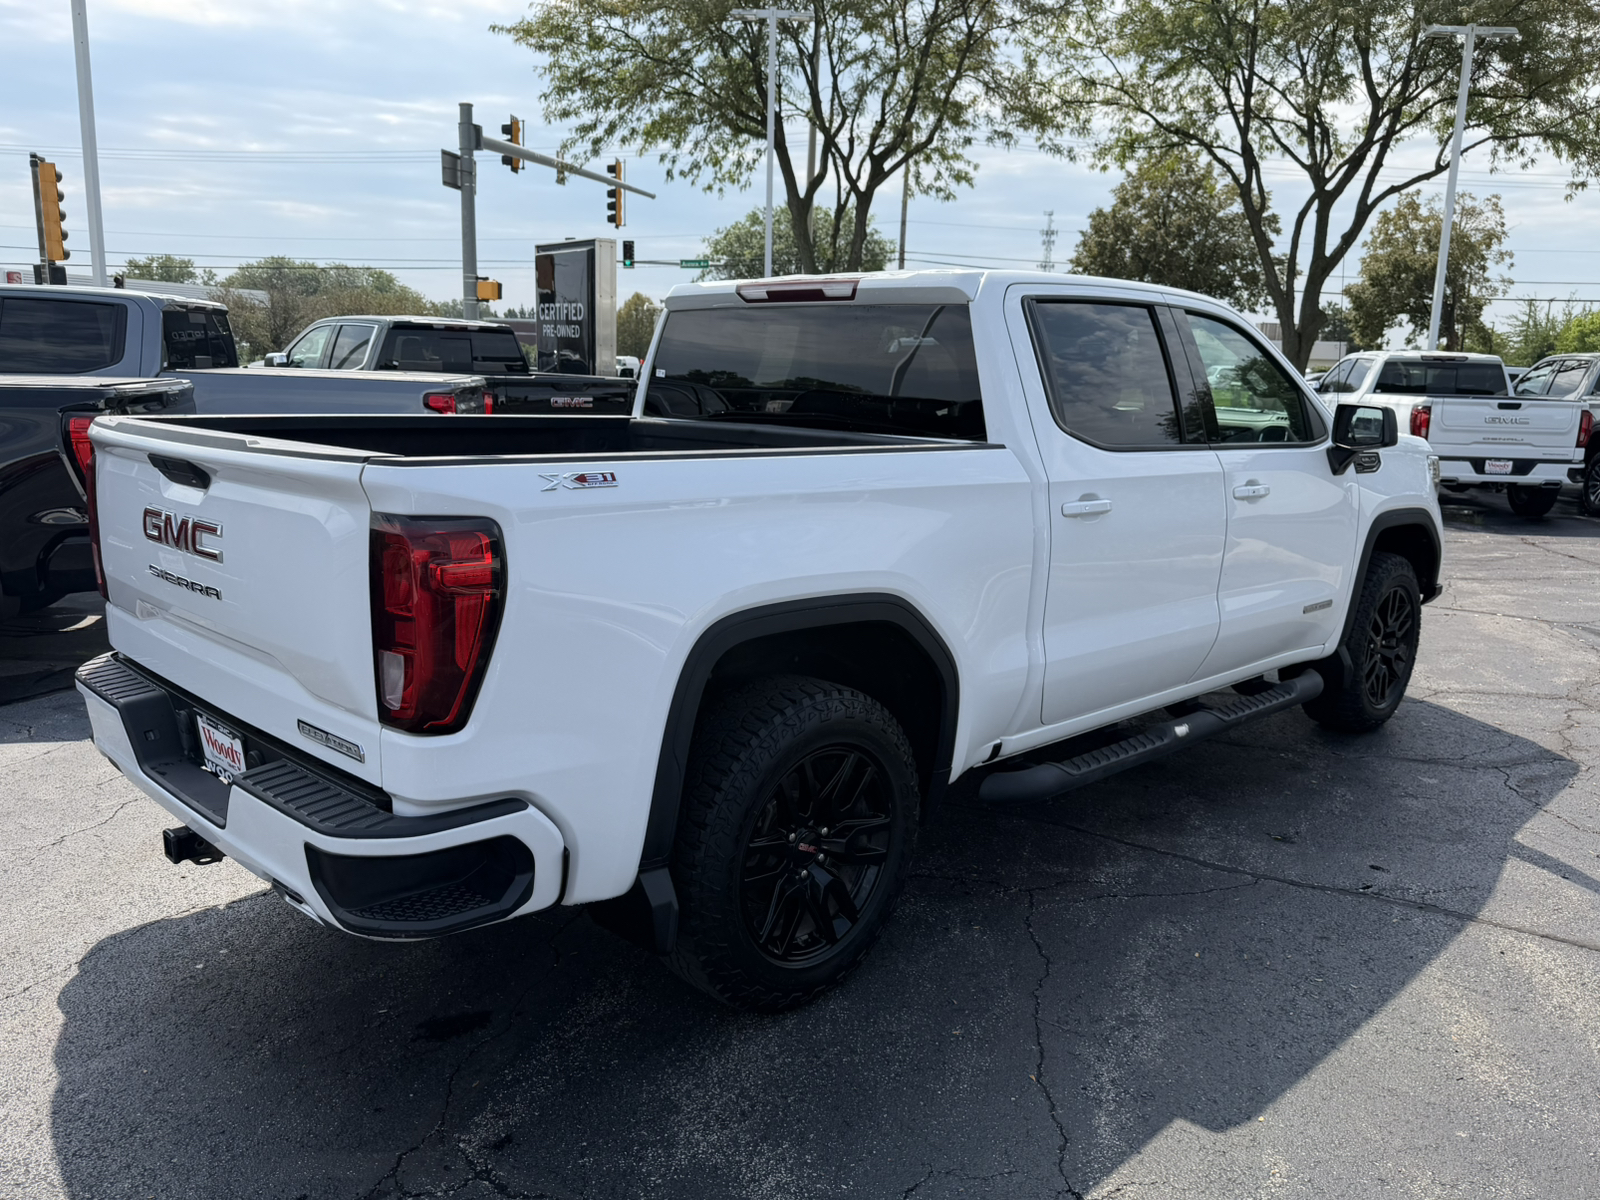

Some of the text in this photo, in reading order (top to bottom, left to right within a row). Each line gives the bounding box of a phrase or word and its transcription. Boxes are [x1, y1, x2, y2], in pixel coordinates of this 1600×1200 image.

[539, 302, 584, 321] CERTIFIED
[542, 324, 581, 339] PRE-OWNED
[551, 397, 594, 408] GMC
[1484, 415, 1530, 425] GMC
[1487, 461, 1511, 470] Woody
[143, 503, 224, 566] GMC
[148, 563, 222, 601] SIERRA
[201, 725, 242, 772] Woody
[300, 723, 360, 758] ELEVATION
[798, 842, 818, 854] GMC
